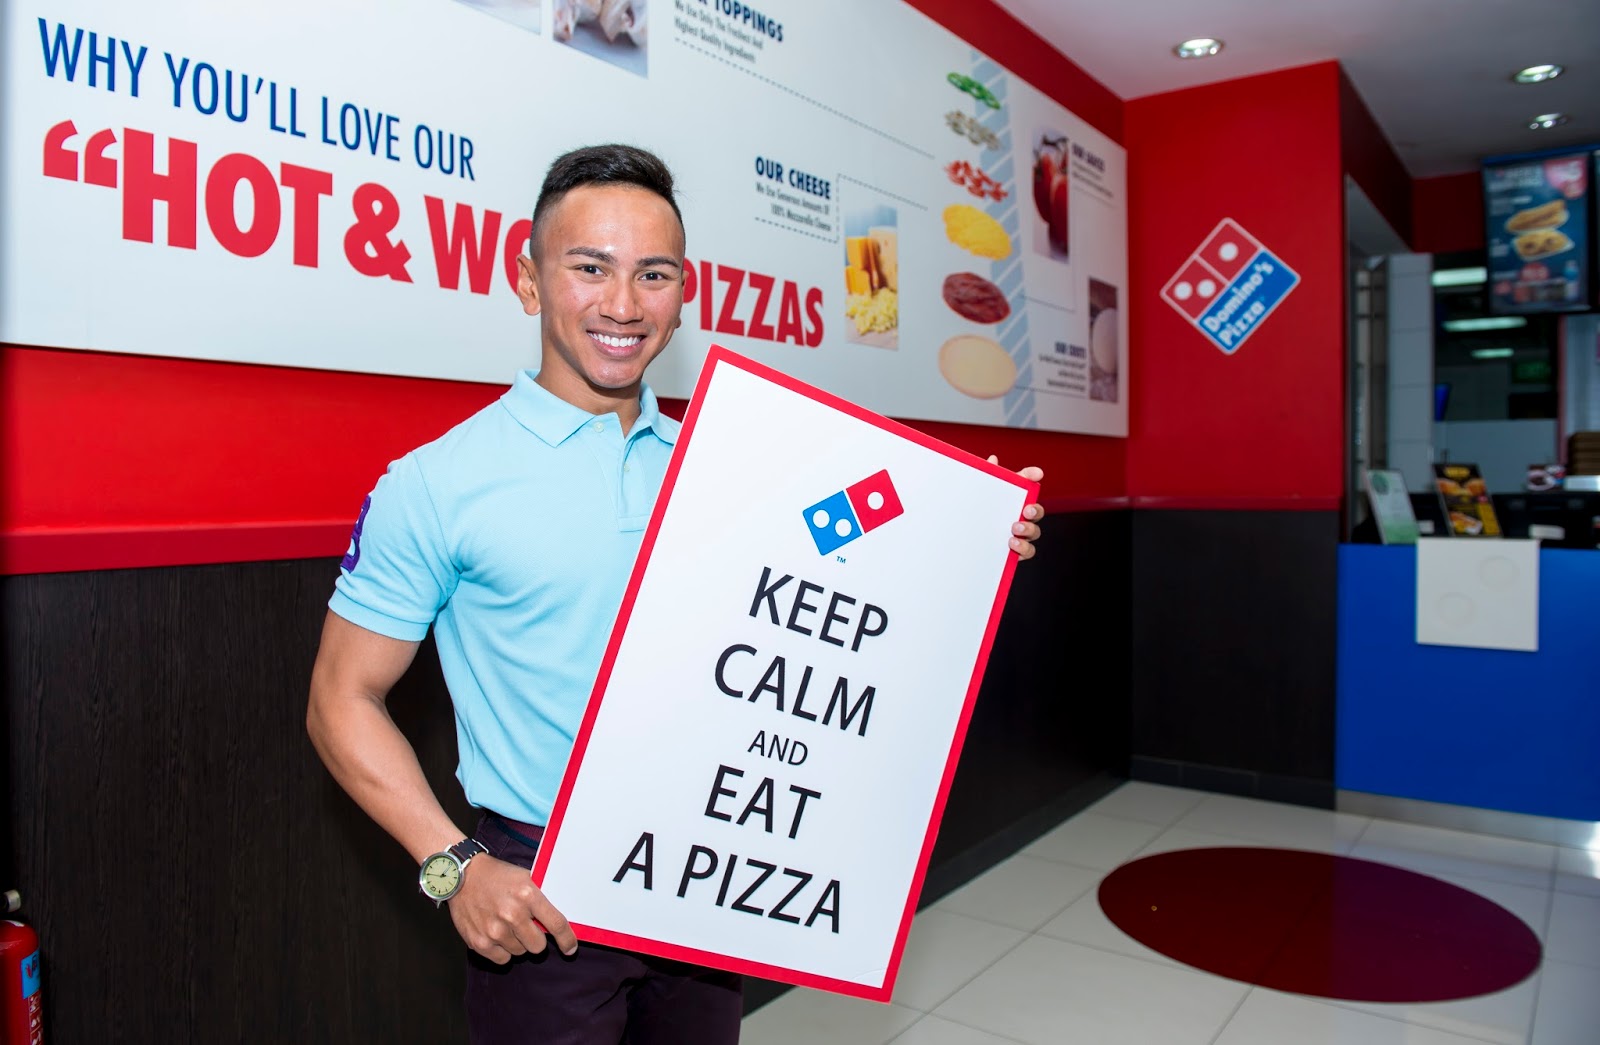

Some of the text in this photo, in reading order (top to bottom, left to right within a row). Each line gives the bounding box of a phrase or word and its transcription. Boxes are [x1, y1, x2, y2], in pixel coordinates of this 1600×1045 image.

[38, 18, 475, 181] WHY YOU'LL LOVE OUR
[755, 156, 830, 200] OUR CHEESE
[343, 182, 413, 284] &
[1203, 261, 1274, 332] Domino's
[1218, 300, 1265, 346] Pizza
[836, 555, 847, 564] TM
[748, 566, 888, 653] KEEP
[714, 643, 876, 737] CALM
[747, 730, 808, 766] AND
[704, 764, 822, 840] EAT
[612, 831, 841, 934] A PIZZA
